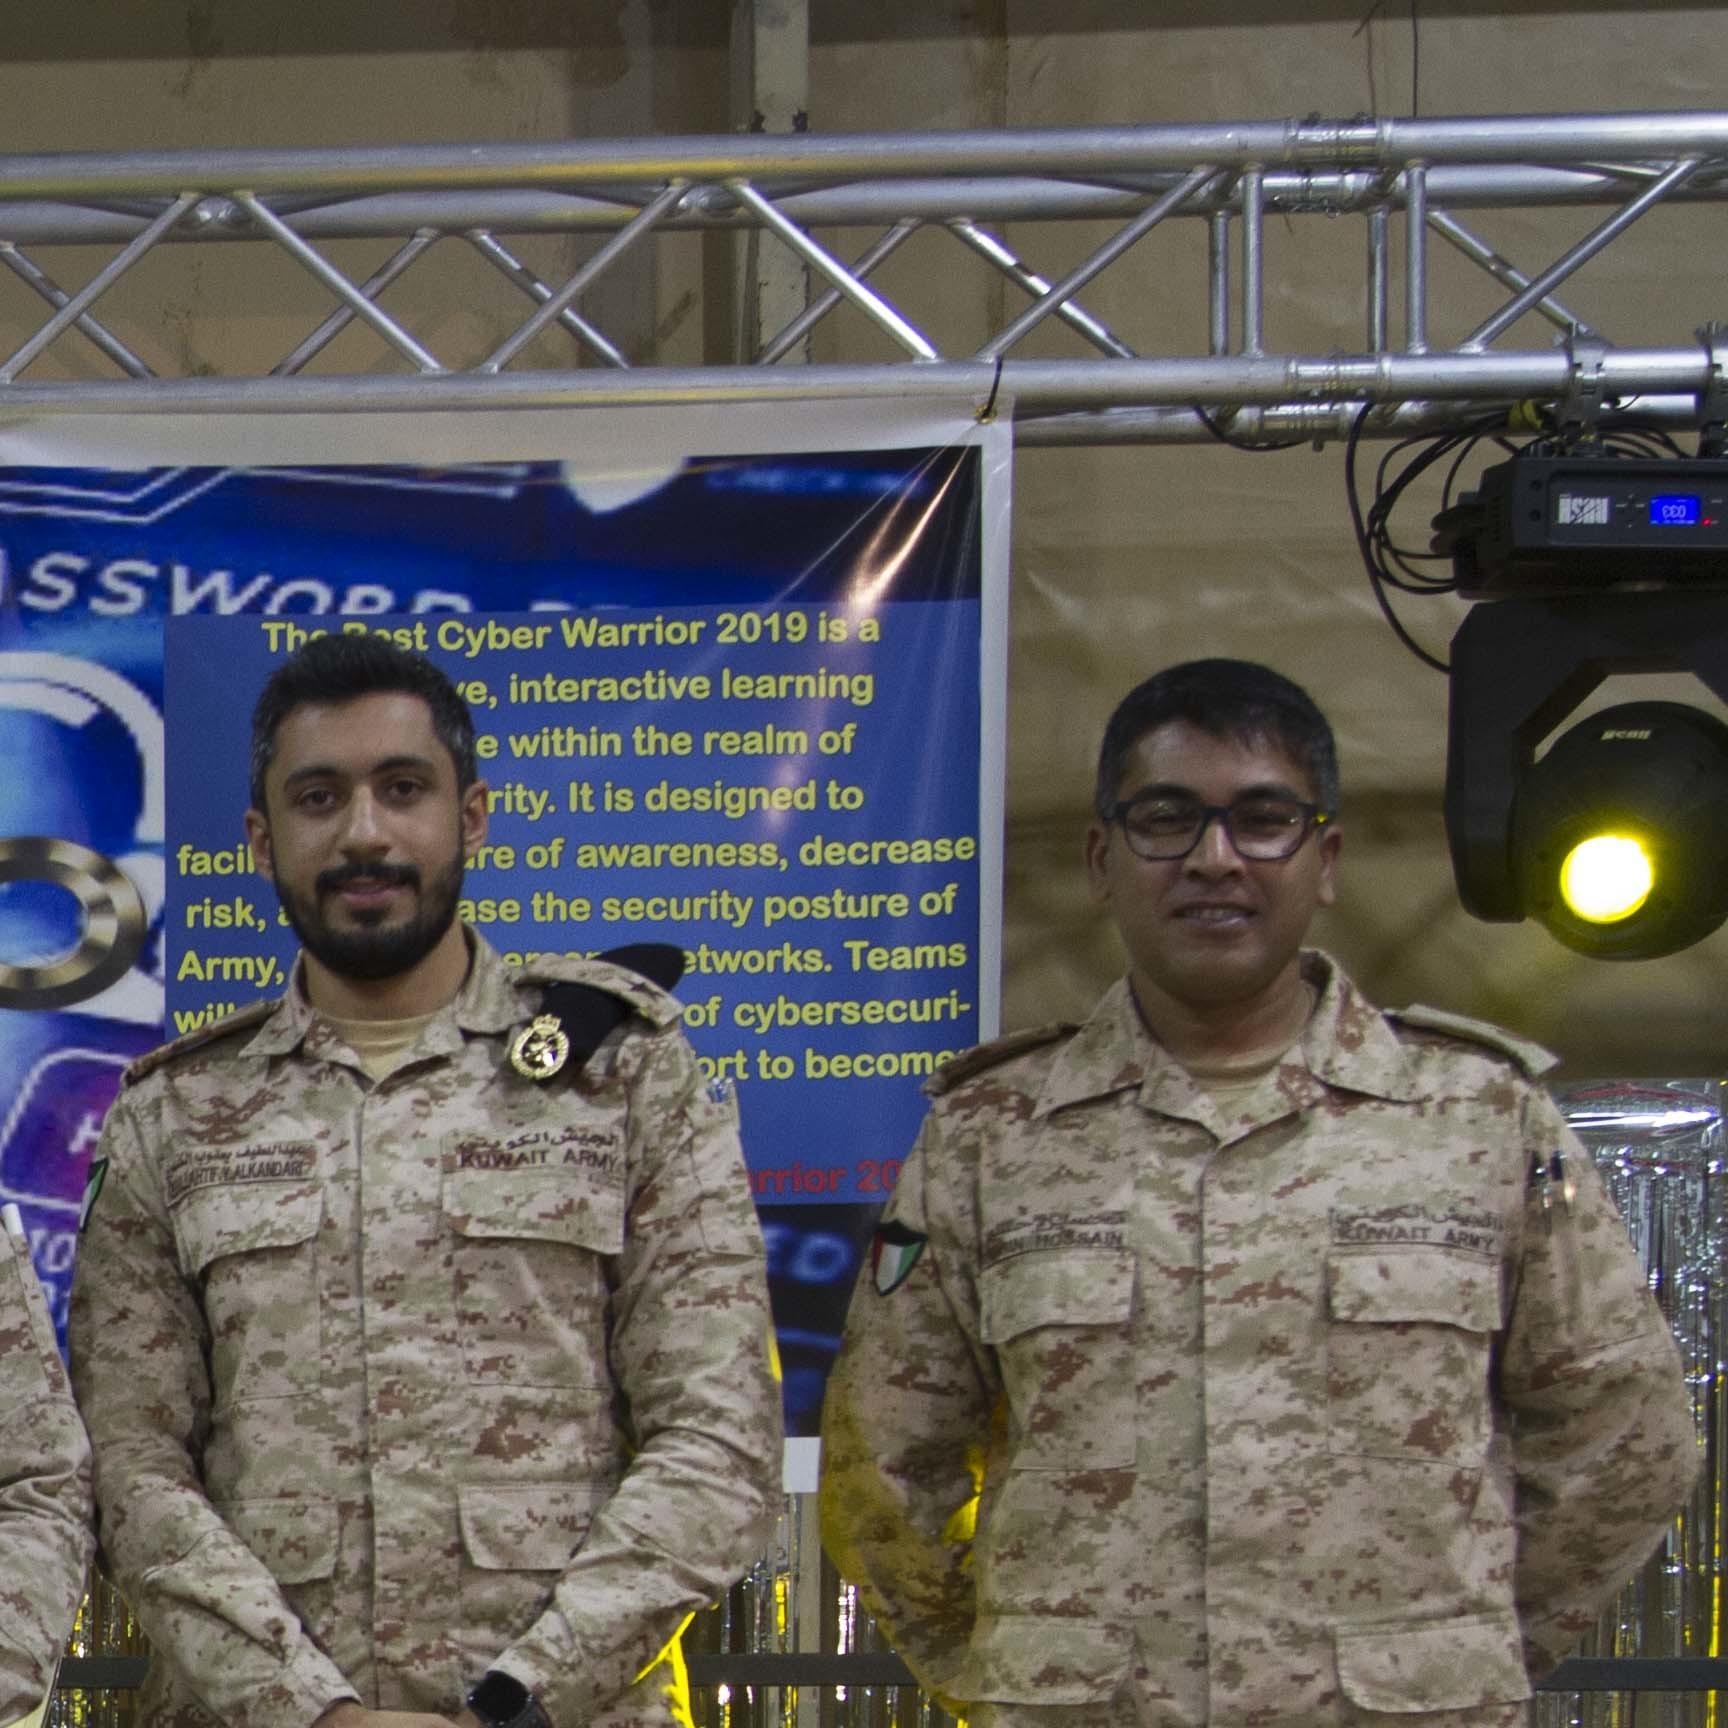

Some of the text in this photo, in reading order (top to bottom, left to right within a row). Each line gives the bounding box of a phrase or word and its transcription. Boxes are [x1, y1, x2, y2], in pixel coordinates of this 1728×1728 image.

[437, 618, 552, 658] Cyber
[560, 616, 705, 649] Warrior
[715, 612, 809, 644] 2019
[818, 611, 848, 643] is
[857, 618, 880, 643] a
[509, 669, 712, 703] interactive
[721, 667, 874, 706] learning
[509, 726, 622, 758] within
[632, 725, 694, 756] the
[703, 724, 808, 756] realm
[818, 722, 858, 755] of
[569, 782, 595, 813] It
[603, 781, 635, 813] is
[644, 780, 816, 820] designed
[826, 780, 865, 812] to
[525, 837, 565, 870] of
[576, 840, 790, 873] awareness,
[799, 834, 976, 868] decrease
[186, 896, 267, 933] risk,
[531, 891, 592, 923] the
[601, 889, 752, 928] security
[763, 887, 910, 926] posture
[919, 883, 960, 917] of
[176, 940, 968, 988] Army, etworks. Teams
[683, 997, 724, 1028] of
[733, 989, 973, 1034] cybersecuri-
[757, 1049, 795, 1080] to
[748, 1161, 847, 1194] rrior
